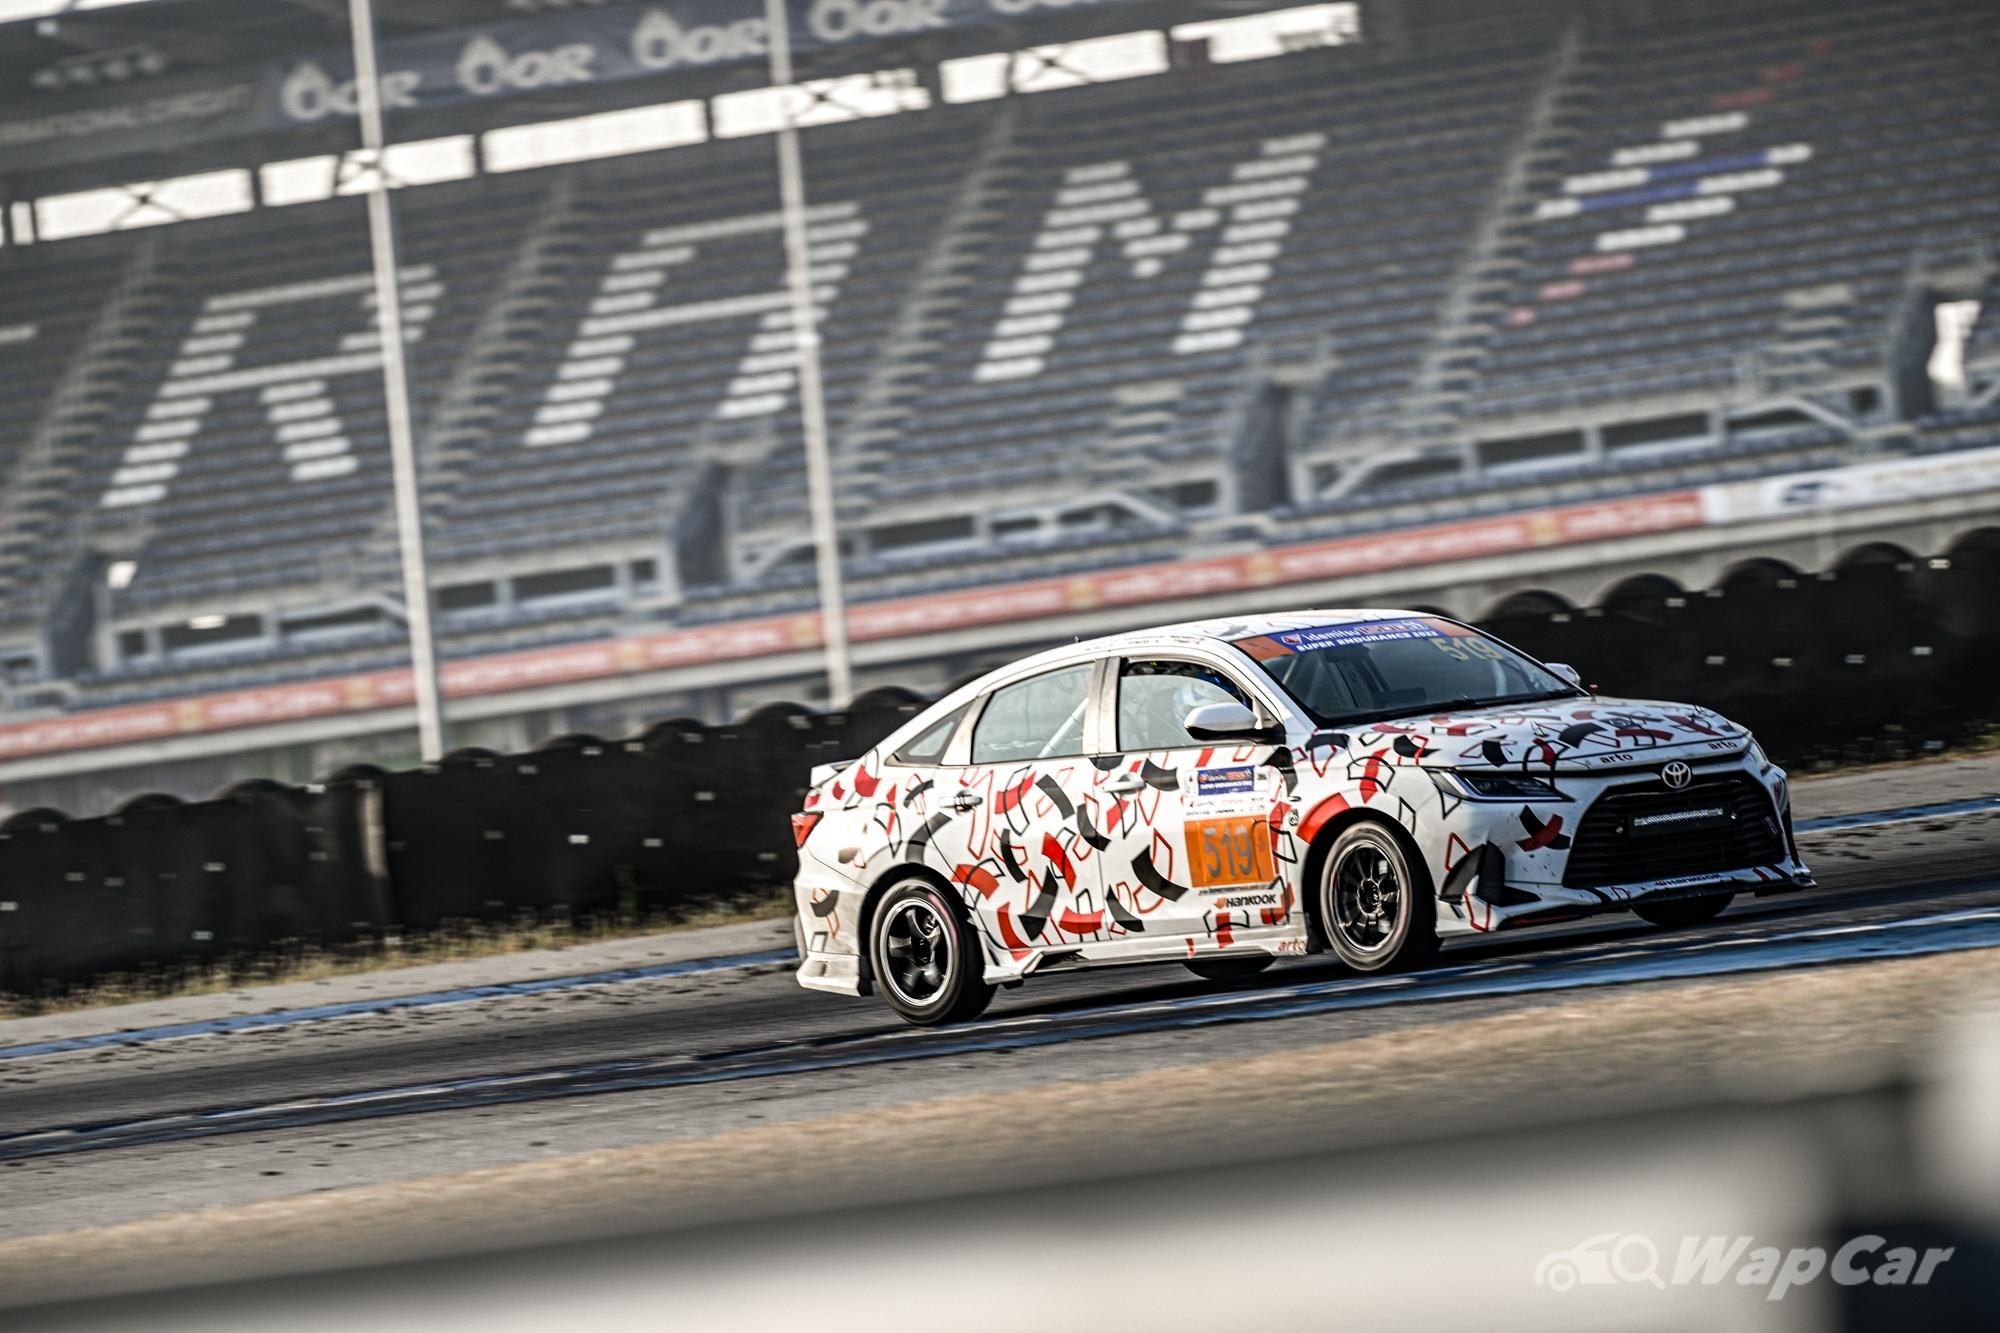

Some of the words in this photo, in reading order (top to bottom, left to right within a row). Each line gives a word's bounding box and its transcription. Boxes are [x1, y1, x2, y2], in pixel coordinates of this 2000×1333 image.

[1296, 640, 1335, 652] SUPER
[1337, 631, 1412, 646] ENDURANCE
[1430, 637, 1504, 661] 519
[1707, 740, 1738, 750] arto
[1600, 752, 1633, 764] arto
[1204, 823, 1252, 878] 519
